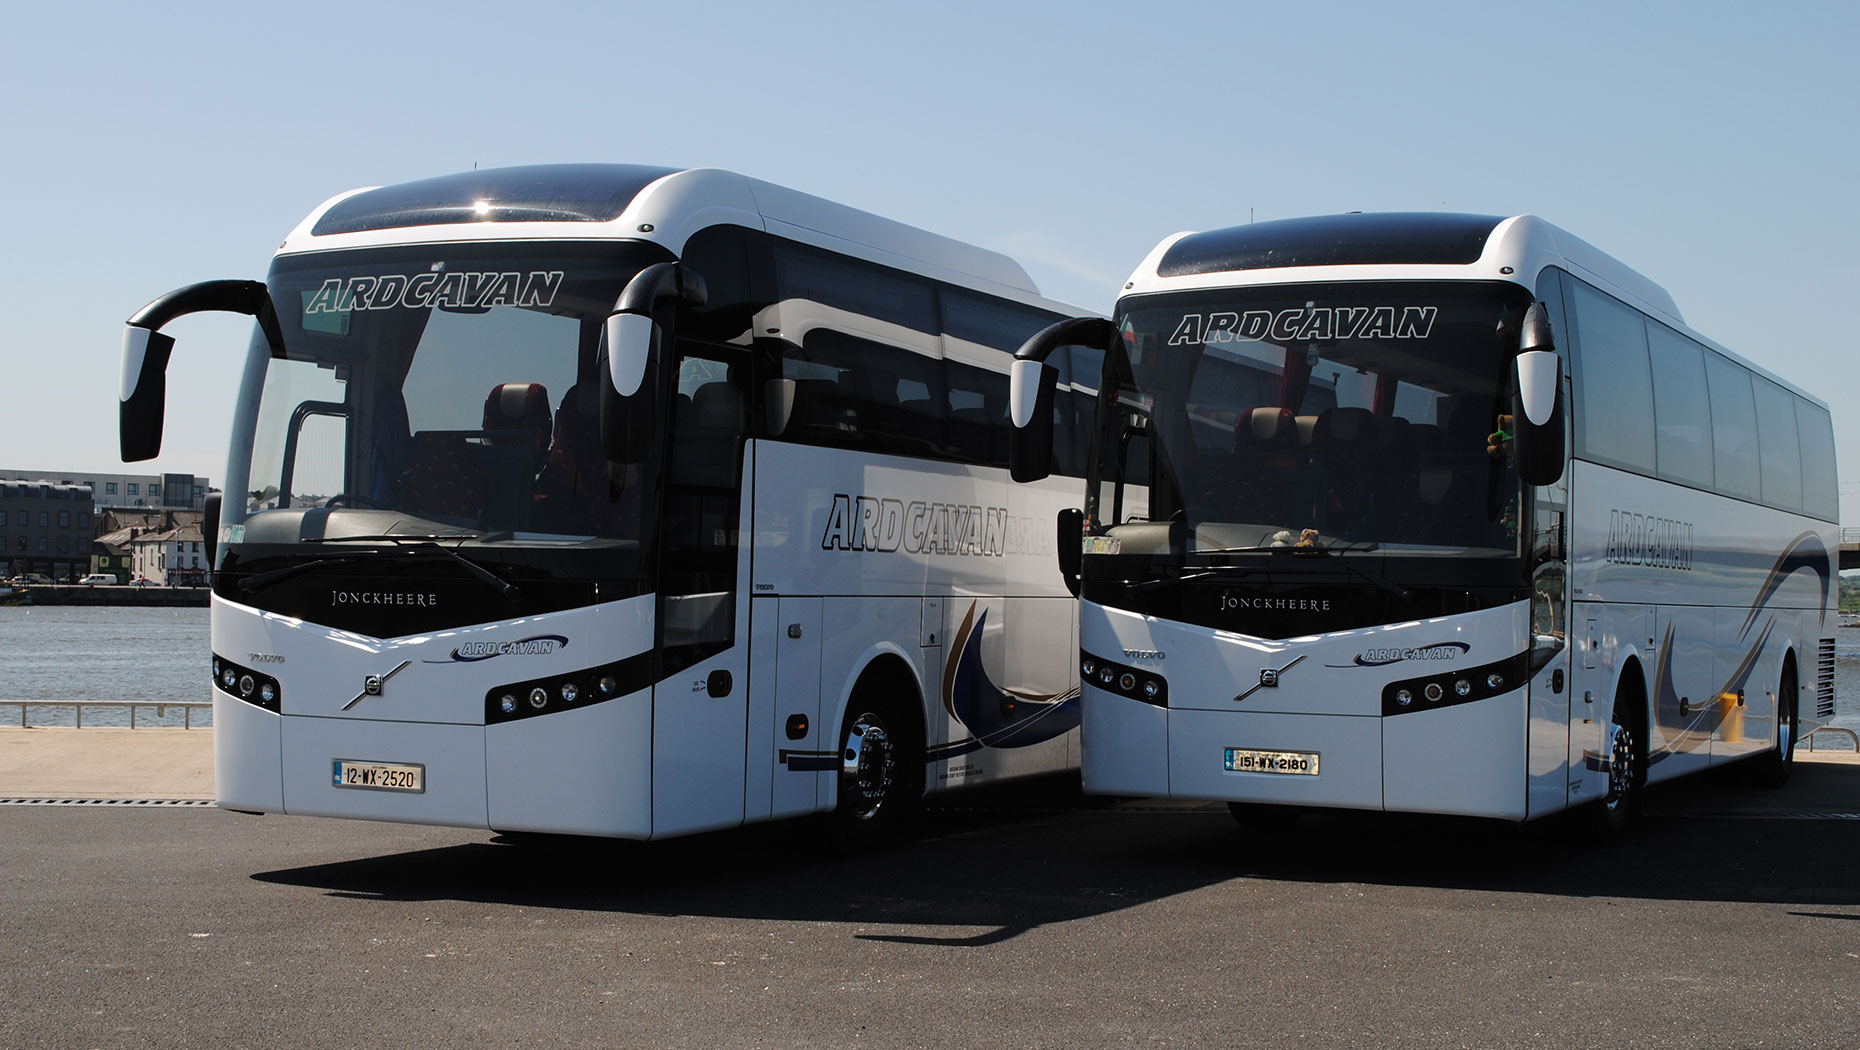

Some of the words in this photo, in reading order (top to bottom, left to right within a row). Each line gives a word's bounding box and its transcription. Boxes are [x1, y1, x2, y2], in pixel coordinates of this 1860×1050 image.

[306, 271, 564, 313] ARDCAVAN
[1168, 307, 1438, 345] ARDCAVAN
[822, 493, 1007, 556] ARDCAVAN
[1606, 509, 1693, 571] ARDCAVAN
[332, 590, 437, 607] JONCKHEERE
[1221, 596, 1330, 612] JONCKHEERE
[461, 641, 554, 656] ARDCAVAN
[1123, 648, 1166, 660] VOLVO
[1364, 647, 1456, 660] ARDCAVAN
[247, 653, 285, 663] VOLVO
[346, 767, 414, 788] 12-WX-2520
